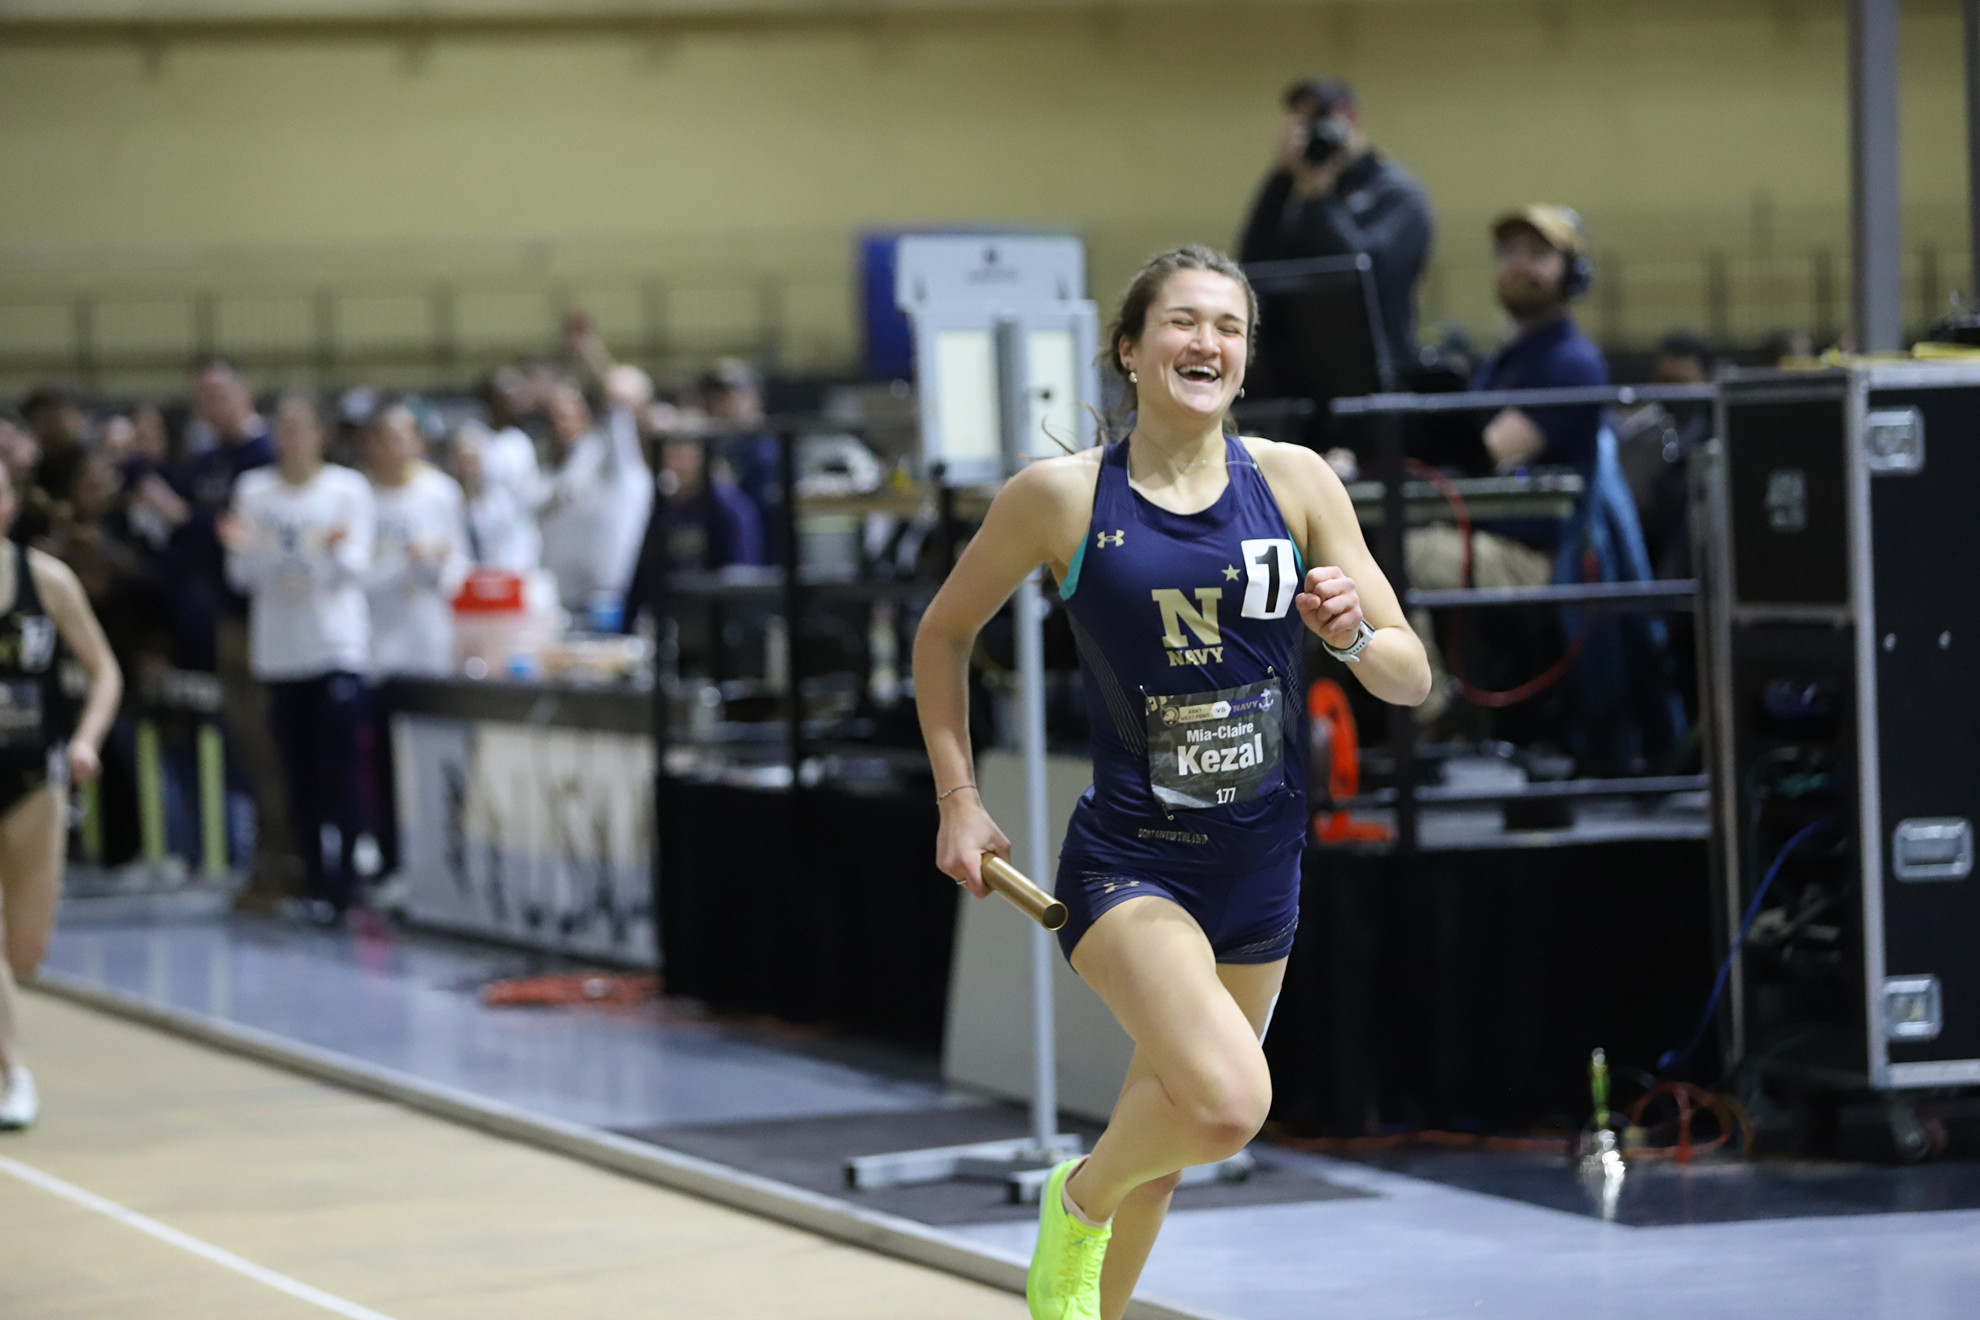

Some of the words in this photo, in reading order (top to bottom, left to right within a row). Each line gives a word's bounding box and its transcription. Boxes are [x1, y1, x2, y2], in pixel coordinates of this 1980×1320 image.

[1254, 545, 1280, 613] 1
[1151, 587, 1223, 649] N
[1167, 645, 1224, 667] NAVY
[1233, 699, 1259, 712] NAVY
[1187, 722, 1254, 743] Mia-Claire
[1177, 732, 1264, 776] Kezal
[1215, 787, 1236, 804] 177
